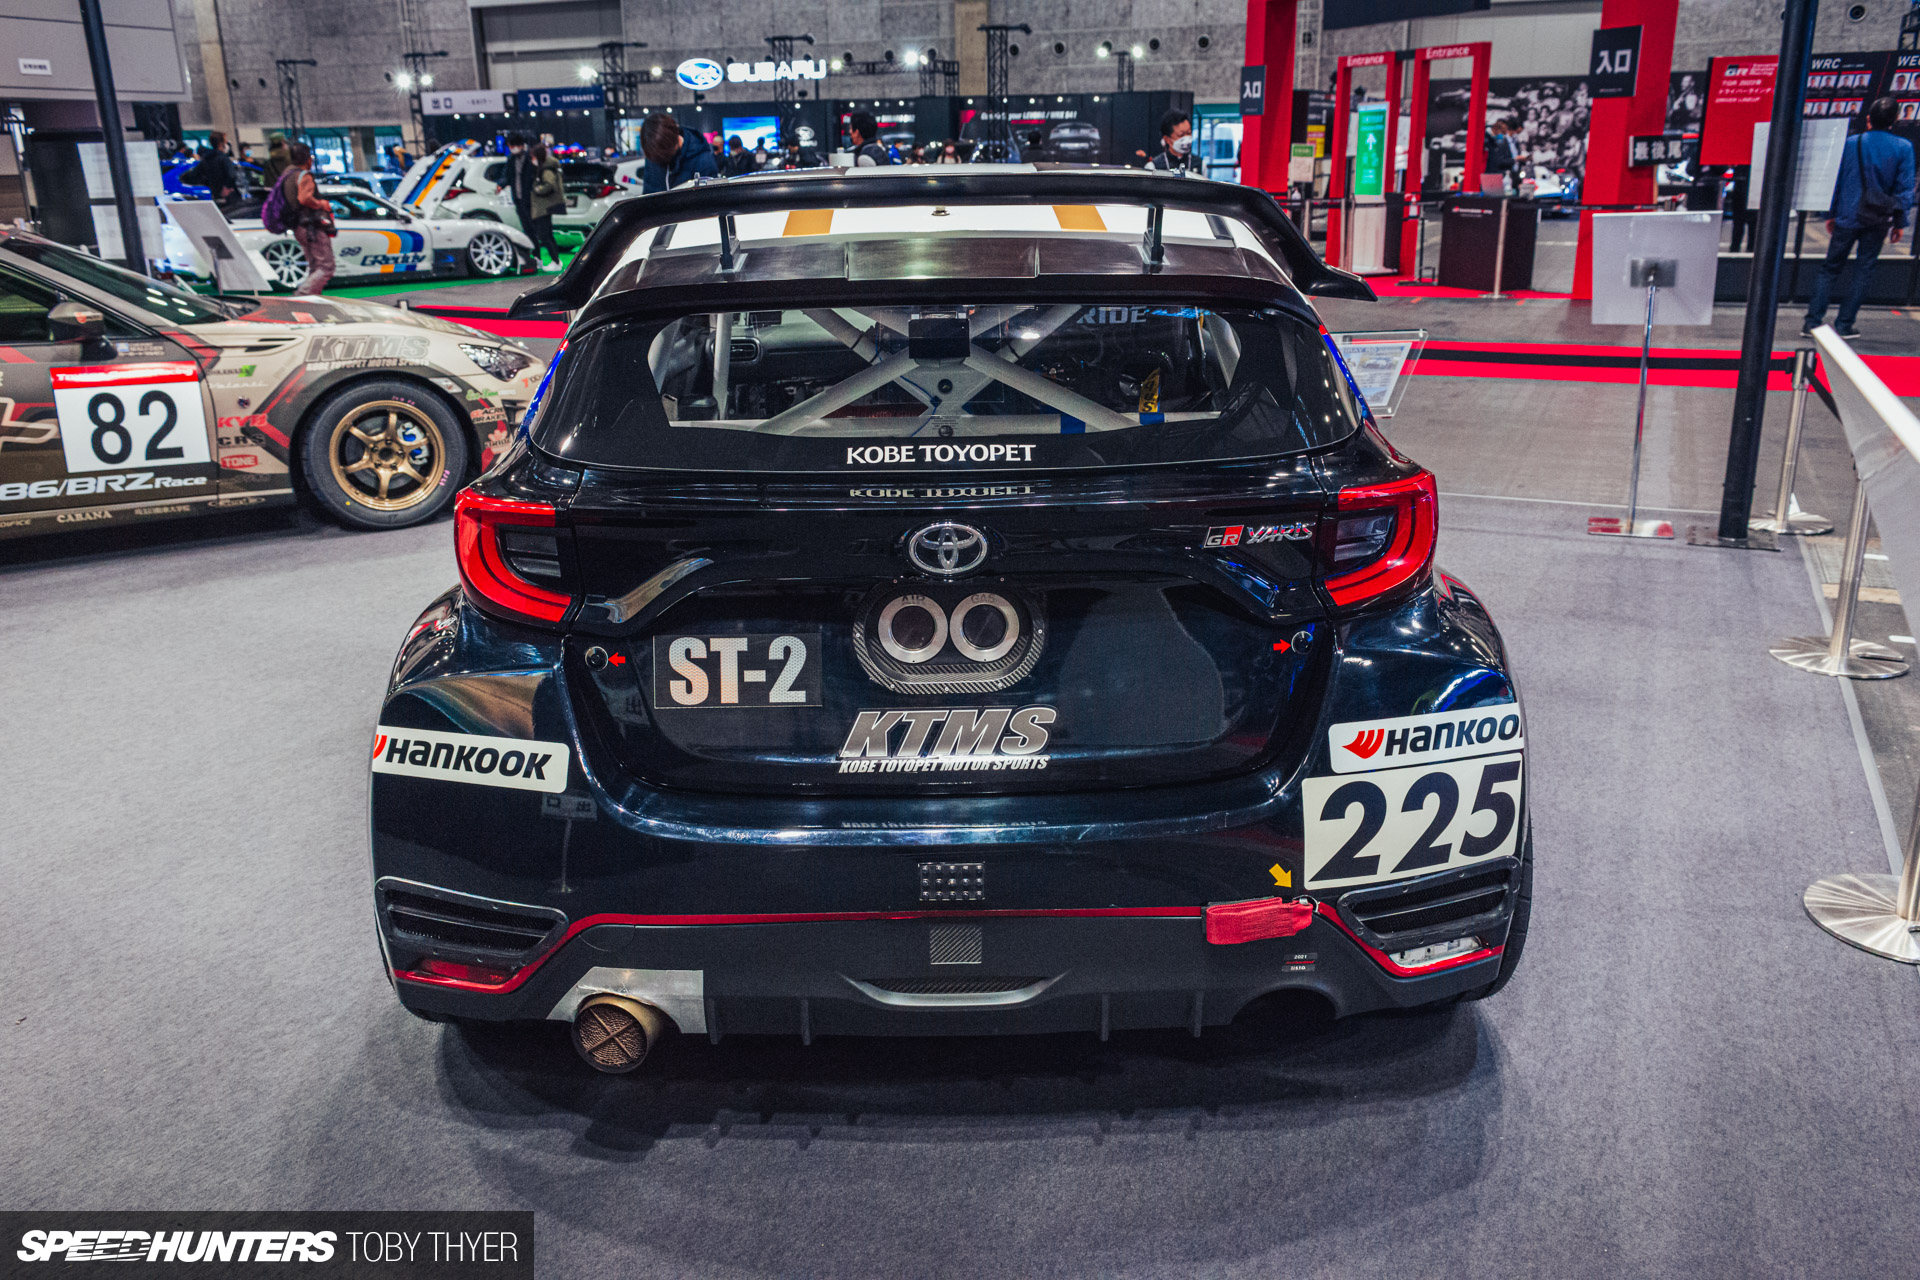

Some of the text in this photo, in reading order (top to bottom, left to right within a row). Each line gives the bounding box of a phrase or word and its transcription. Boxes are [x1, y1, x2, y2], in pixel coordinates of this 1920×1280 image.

[1347, 54, 1385, 66] Entrance
[1426, 46, 1470, 59] Entrance
[1595, 49, 1632, 74] 入口
[1811, 58, 1842, 69] WRC
[1897, 55, 1920, 66] WE
[727, 59, 827, 83] SUBARU
[527, 93, 550, 106] 入口
[1243, 81, 1262, 98] 入口
[305, 335, 430, 362] KTMS
[88, 390, 184, 465] 82
[218, 413, 268, 428] KYB
[223, 456, 256, 467] TONE
[846, 444, 1037, 464] KOBE TOYOPET
[0, 472, 208, 501] 86/BRZ Race
[1206, 522, 1317, 546] GR YARIS
[970, 593, 997, 604] GAS
[668, 635, 807, 706] ST-2
[840, 707, 1057, 758] KTMS
[1384, 713, 1523, 757] HANKOO
[384, 737, 553, 781] HANKOOK
[838, 755, 1050, 774] KOBE TOYOPET MOTOR SPORTS
[1308, 760, 1522, 883] 225
